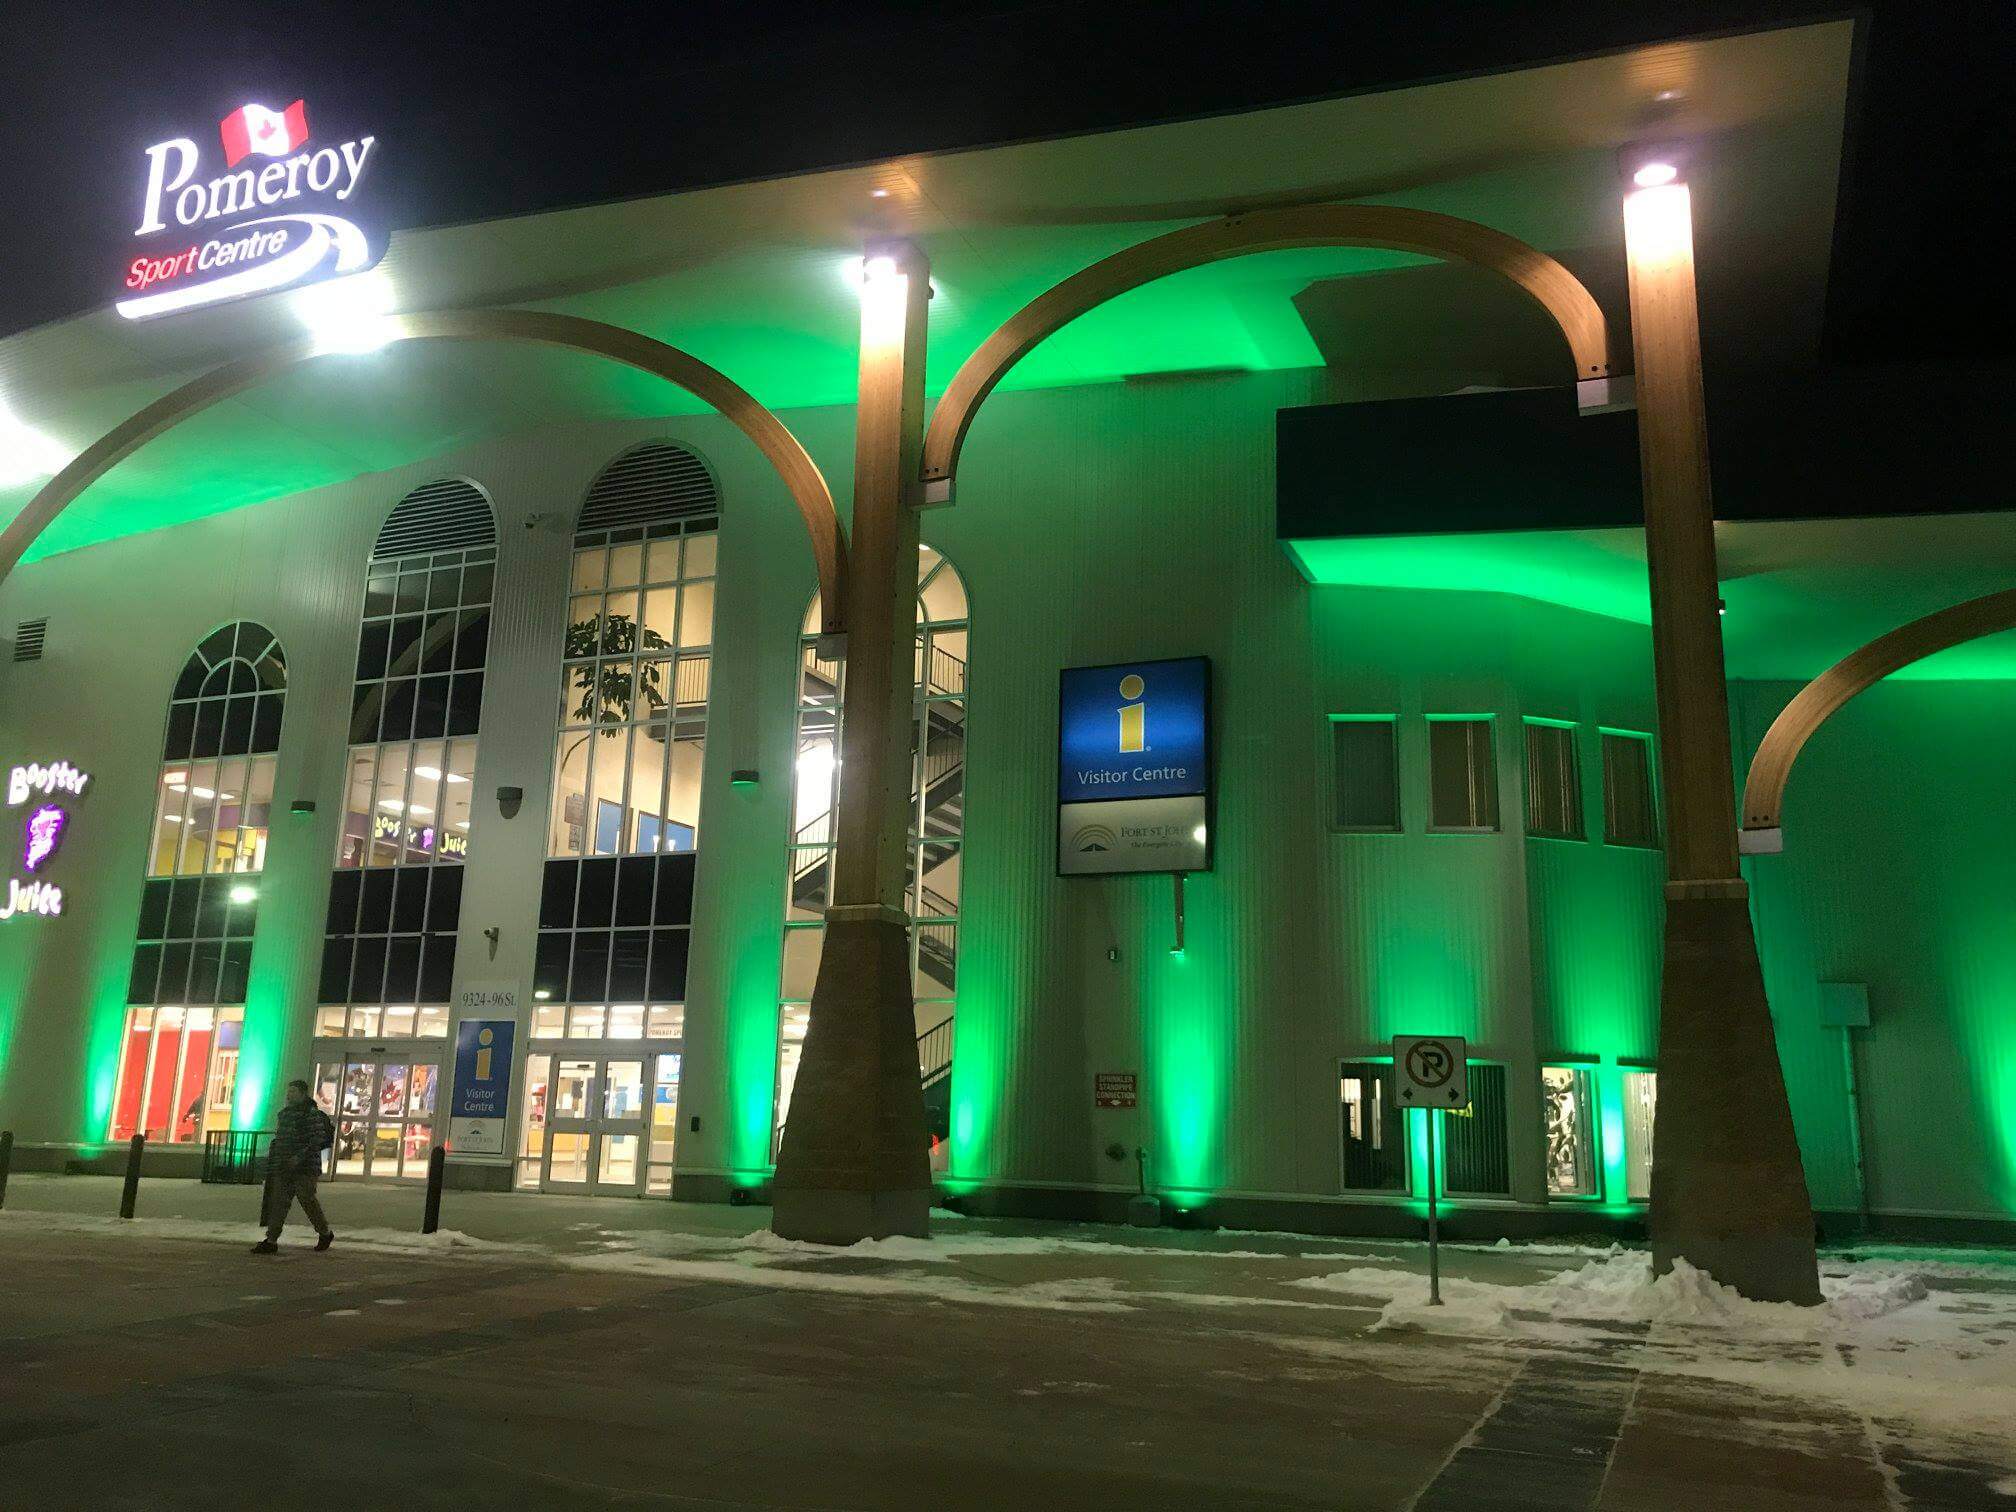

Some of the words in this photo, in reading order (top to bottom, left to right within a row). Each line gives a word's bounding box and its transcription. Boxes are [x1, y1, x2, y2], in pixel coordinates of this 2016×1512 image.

[134, 136, 375, 236] Pomeroy
[1077, 769, 1128, 785] Visitor
[1132, 766, 1188, 782] Centre
[0, 878, 62, 920] Juice
[465, 1087, 496, 1101] Visitor
[464, 1101, 495, 1113] Centre
